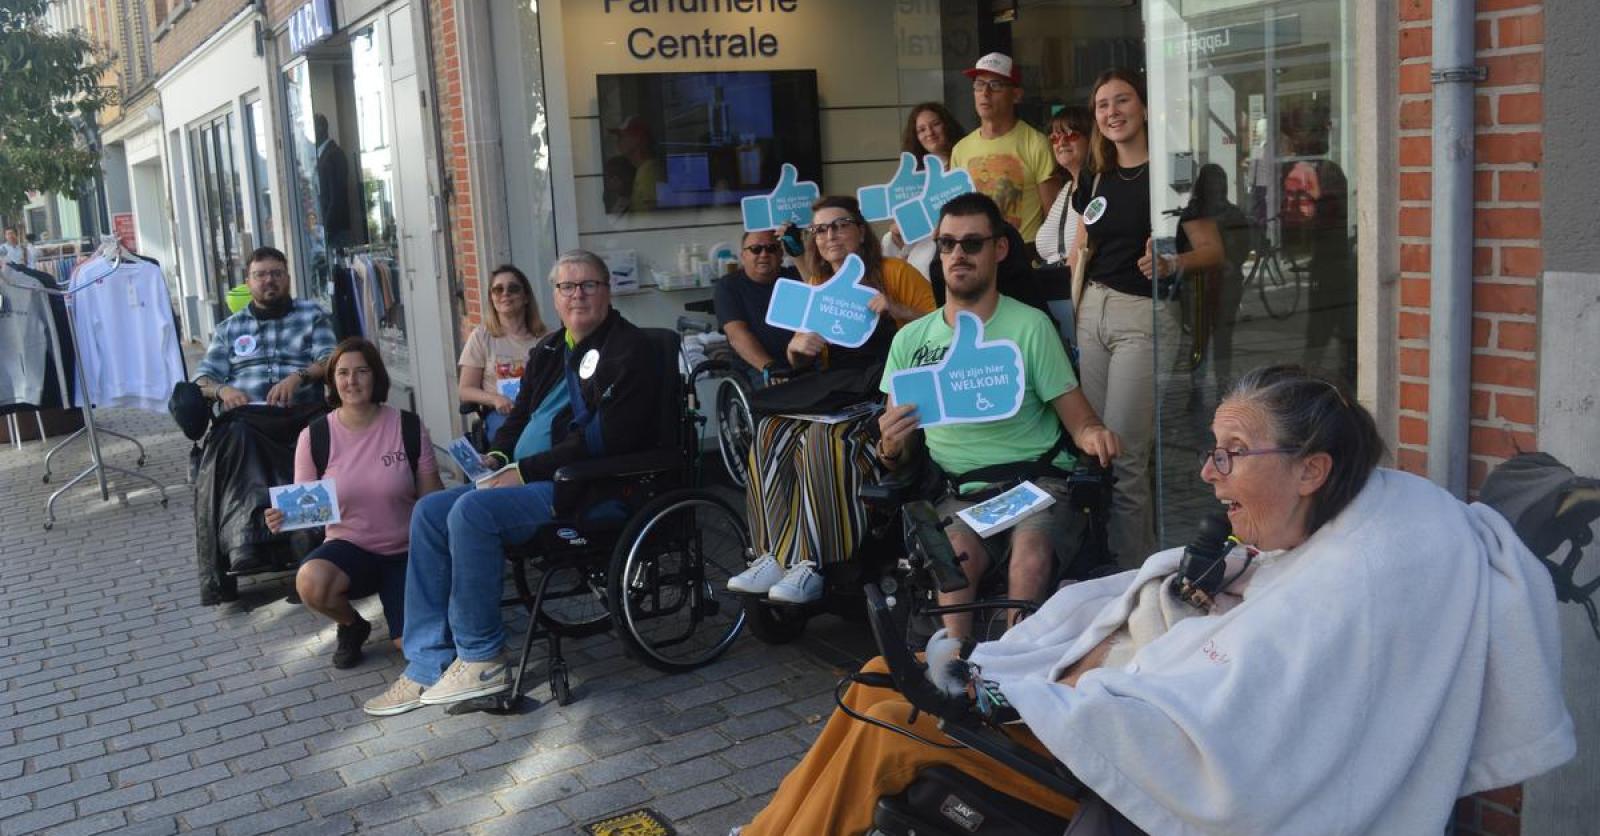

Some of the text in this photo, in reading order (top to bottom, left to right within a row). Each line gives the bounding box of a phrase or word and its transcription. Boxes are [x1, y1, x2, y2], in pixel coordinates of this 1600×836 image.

[288, 0, 324, 54] KARL
[627, 27, 778, 60] Centrale
[820, 304, 867, 322] WELKOM!
[948, 364, 1005, 381] Wij zijn hier
[950, 374, 1009, 392] WELKOM!
